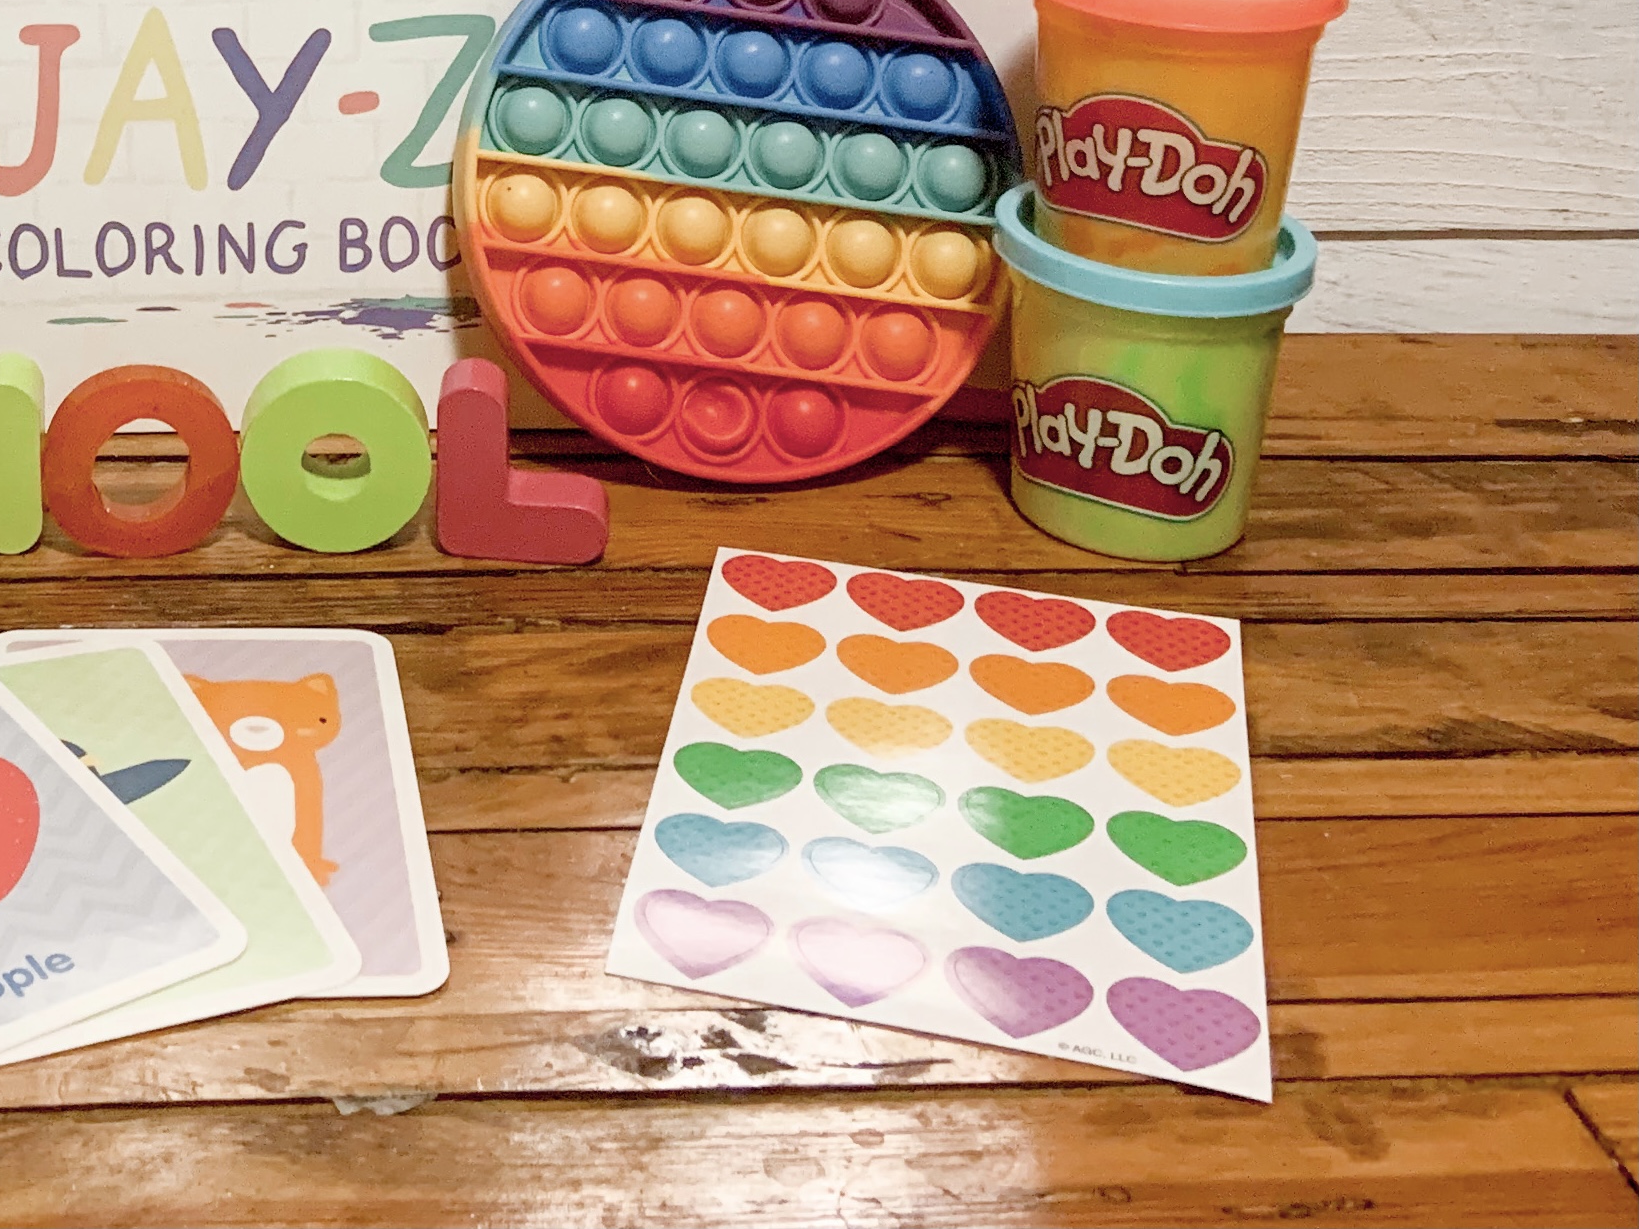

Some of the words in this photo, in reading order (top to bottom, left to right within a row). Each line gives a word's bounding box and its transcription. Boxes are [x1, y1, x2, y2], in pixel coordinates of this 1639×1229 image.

[1036, 106, 1261, 224] Play-Doh
[338, 216, 462, 273] BOO
[1012, 382, 1225, 502] Play-Doh
